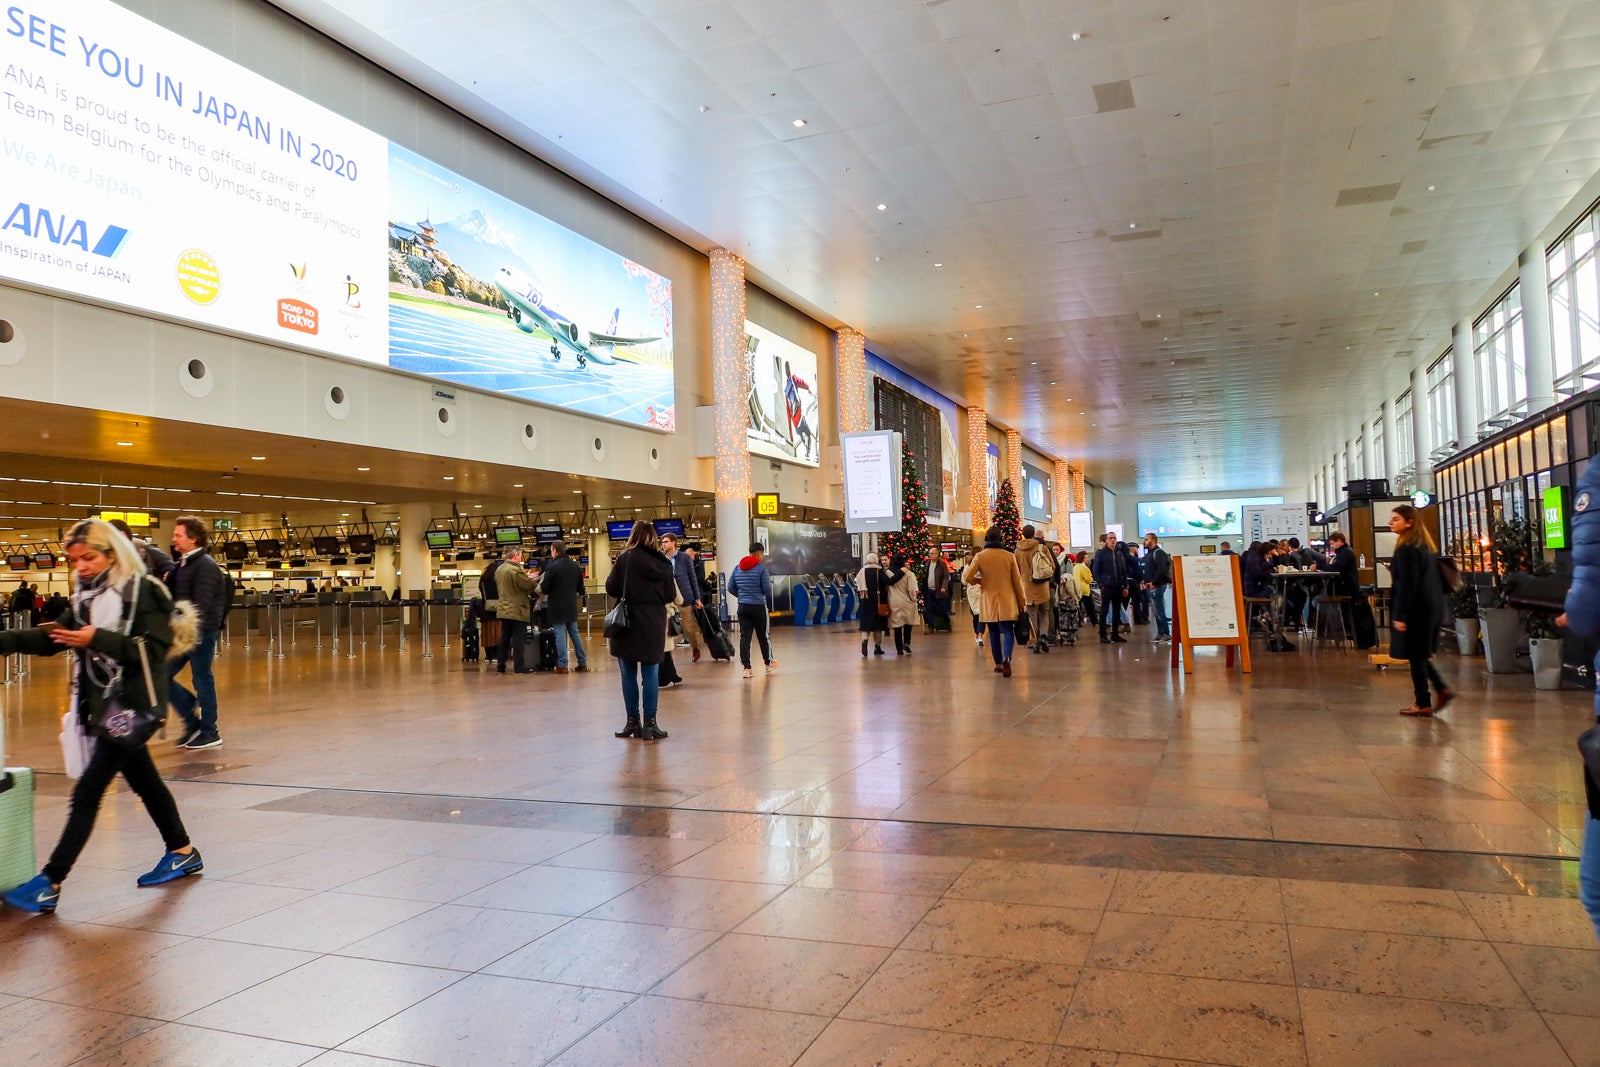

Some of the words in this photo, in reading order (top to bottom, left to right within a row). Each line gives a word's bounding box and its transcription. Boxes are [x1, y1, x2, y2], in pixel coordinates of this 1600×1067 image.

[6, 6, 67, 58] SEE
[78, 35, 145, 89] YOU
[155, 71, 183, 108] IN
[192, 90, 271, 145] JAPAN
[279, 127, 302, 158] IN
[310, 142, 358, 182] 2020
[4, 64, 48, 95] ANA
[55, 82, 69, 102] is
[75, 94, 128, 126] proud
[134, 116, 151, 134] to
[156, 123, 177, 144] be
[181, 135, 207, 157] the
[211, 149, 256, 176] official
[260, 168, 300, 193] carrier
[303, 185, 317, 199] of
[3, 137, 38, 167] We
[43, 152, 80, 180] Are
[3, 91, 56, 127] Team
[62, 114, 135, 156] Belgium
[140, 143, 163, 165] for
[167, 156, 193, 177] the
[198, 165, 262, 202] Olympics
[265, 193, 290, 213] and
[294, 201, 362, 239] Paralympics
[1, 202, 89, 253] ANA
[0, 240, 73, 270] Inspiration
[76, 261, 90, 273] of
[91, 265, 132, 284] JAPAN
[281, 302, 303, 315] ROAD
[304, 308, 316, 318] TO
[281, 310, 316, 329] TOKYO
[761, 502, 775, 512] 05
